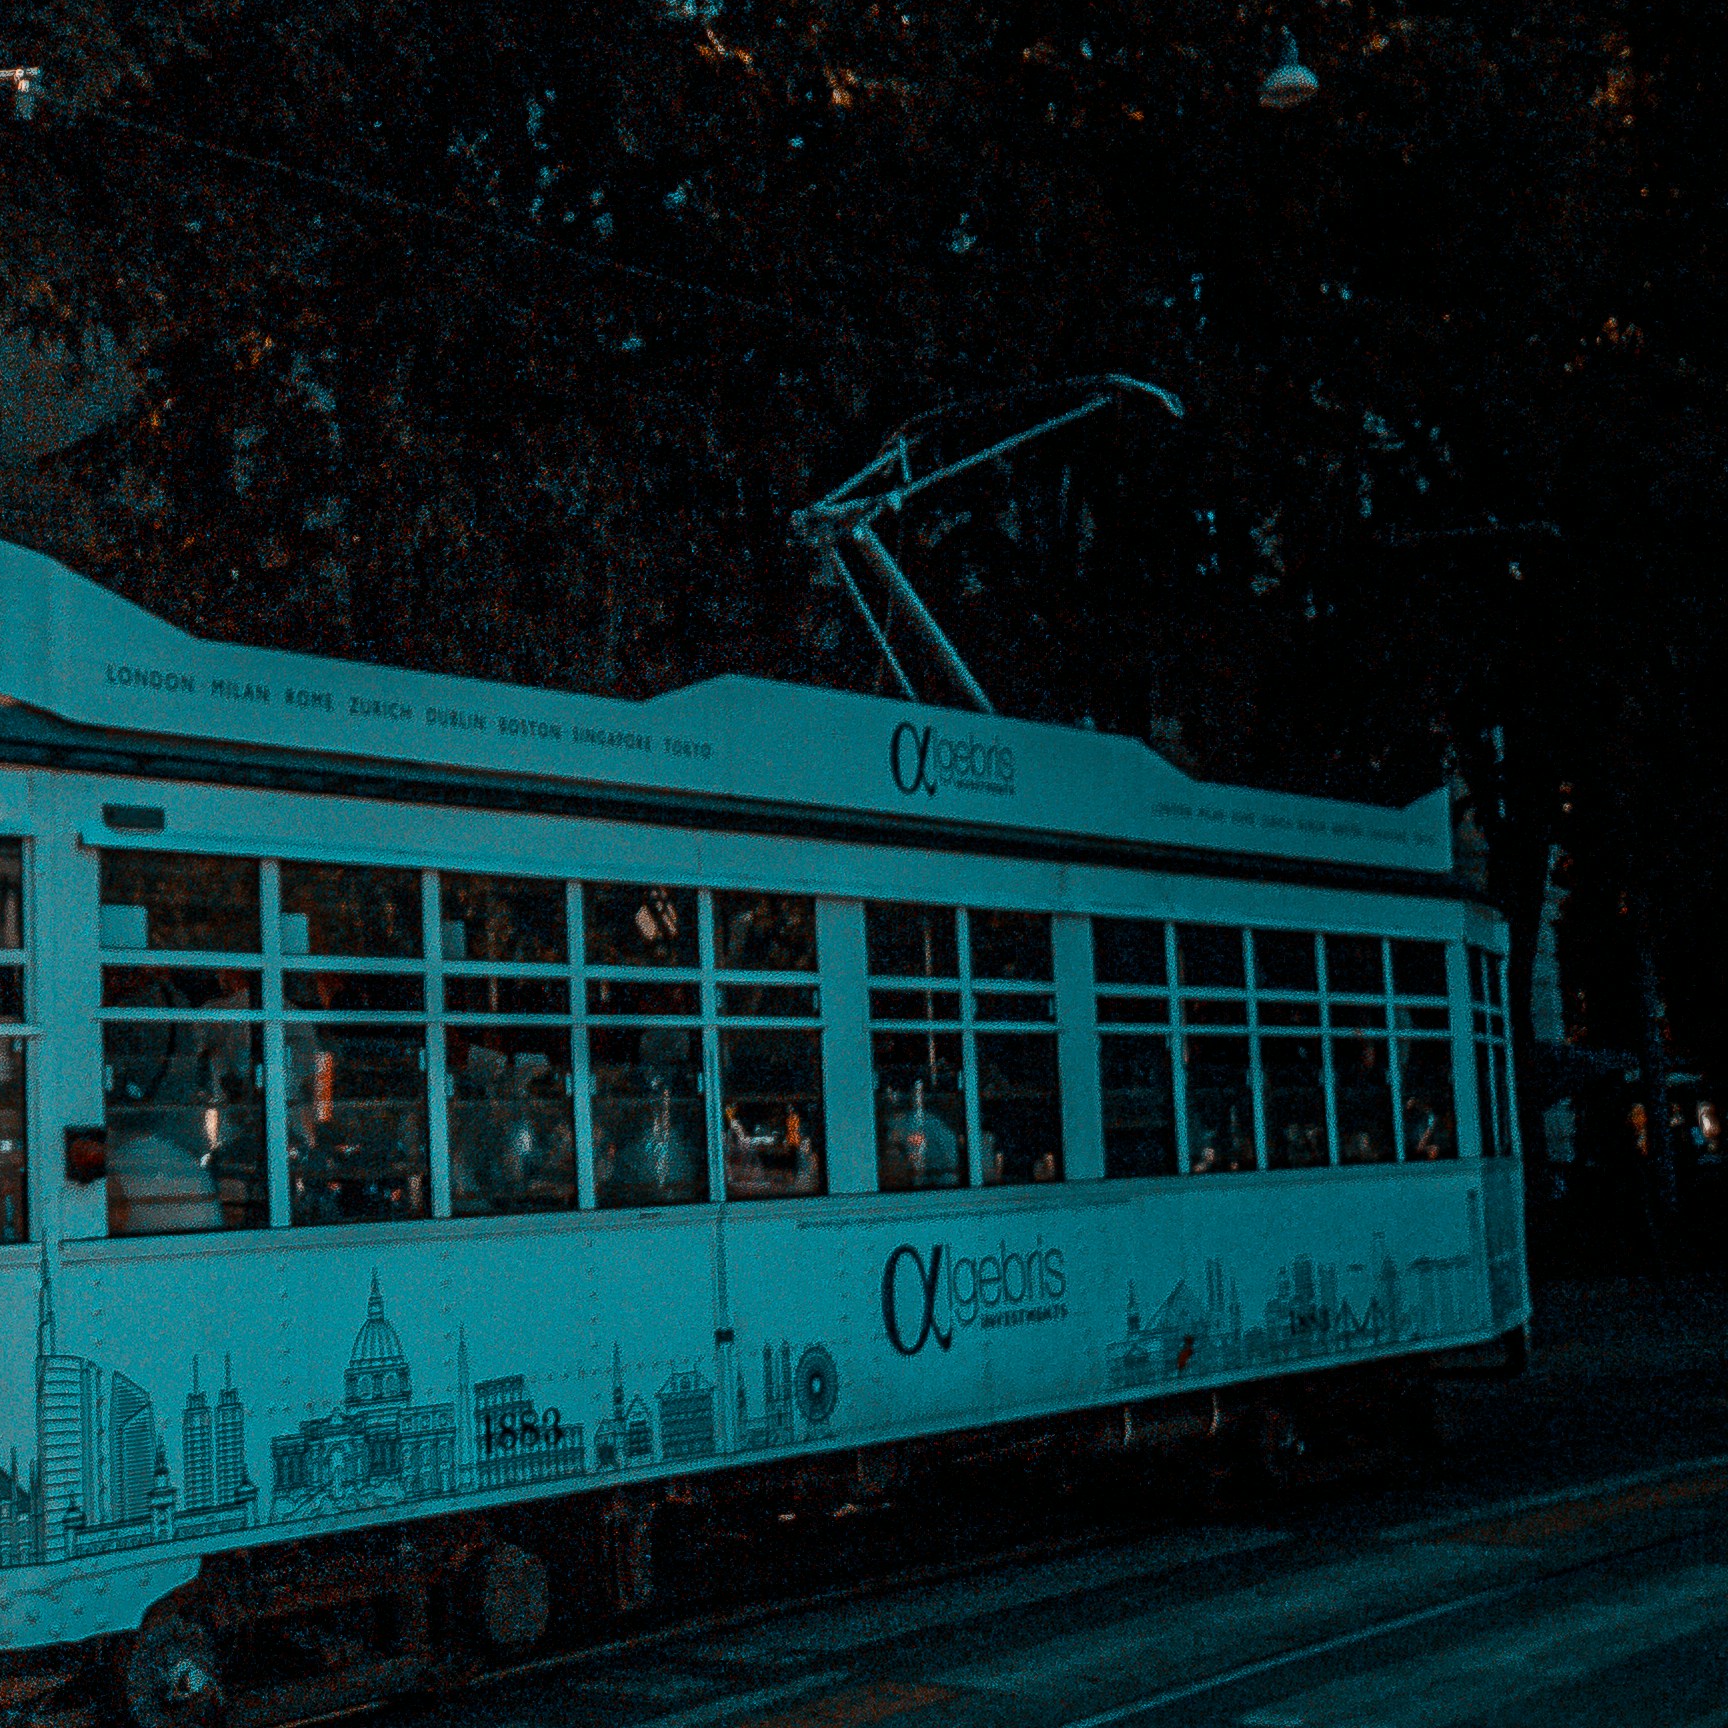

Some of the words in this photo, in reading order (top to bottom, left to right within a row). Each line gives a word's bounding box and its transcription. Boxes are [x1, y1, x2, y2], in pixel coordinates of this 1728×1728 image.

[105, 663, 196, 693] LONDON
[210, 678, 271, 704] MILAN
[284, 686, 334, 713] ROME
[349, 695, 414, 721] ZURICH
[424, 705, 487, 732] DUBLIN
[498, 715, 562, 742] BOSTON
[484, 1407, 563, 1453] 1883
